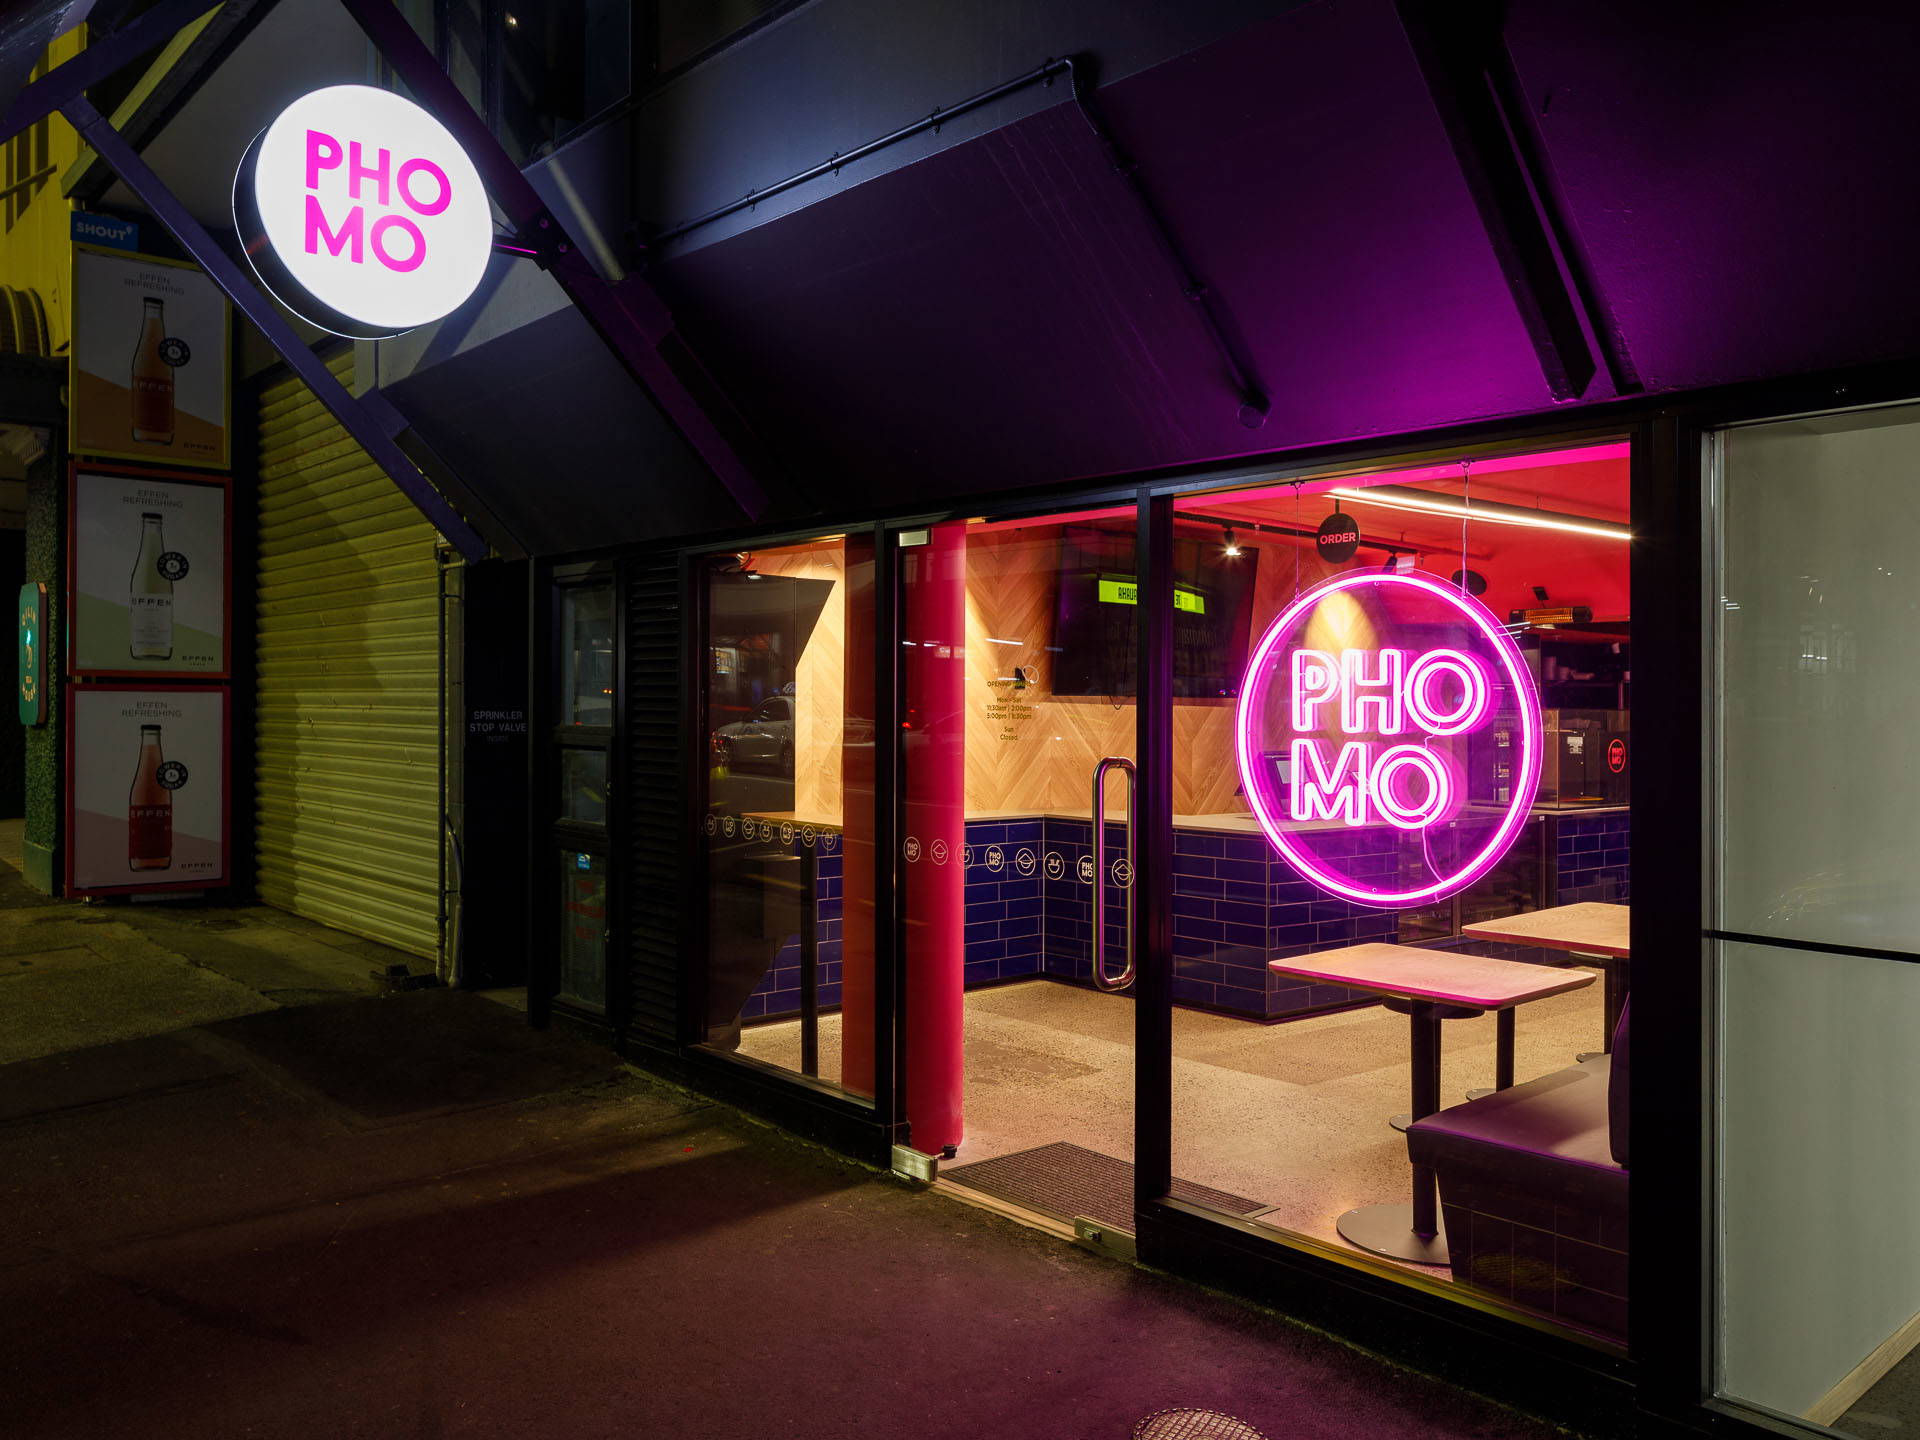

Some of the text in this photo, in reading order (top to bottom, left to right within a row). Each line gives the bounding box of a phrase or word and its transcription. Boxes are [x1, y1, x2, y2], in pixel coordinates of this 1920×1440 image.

[304, 129, 452, 216] PHO
[76, 221, 127, 241] SHOUT
[304, 195, 427, 272] MO
[1319, 531, 1357, 545] ORDER
[1290, 648, 1490, 738] PHO
[136, 701, 168, 709] EFFEN
[121, 709, 183, 718] REFRESHING
[473, 710, 523, 721] SPRINKLER
[469, 722, 528, 733] STOP VALVE
[1290, 738, 1452, 831] MO
[1081, 869, 1093, 878] MO
